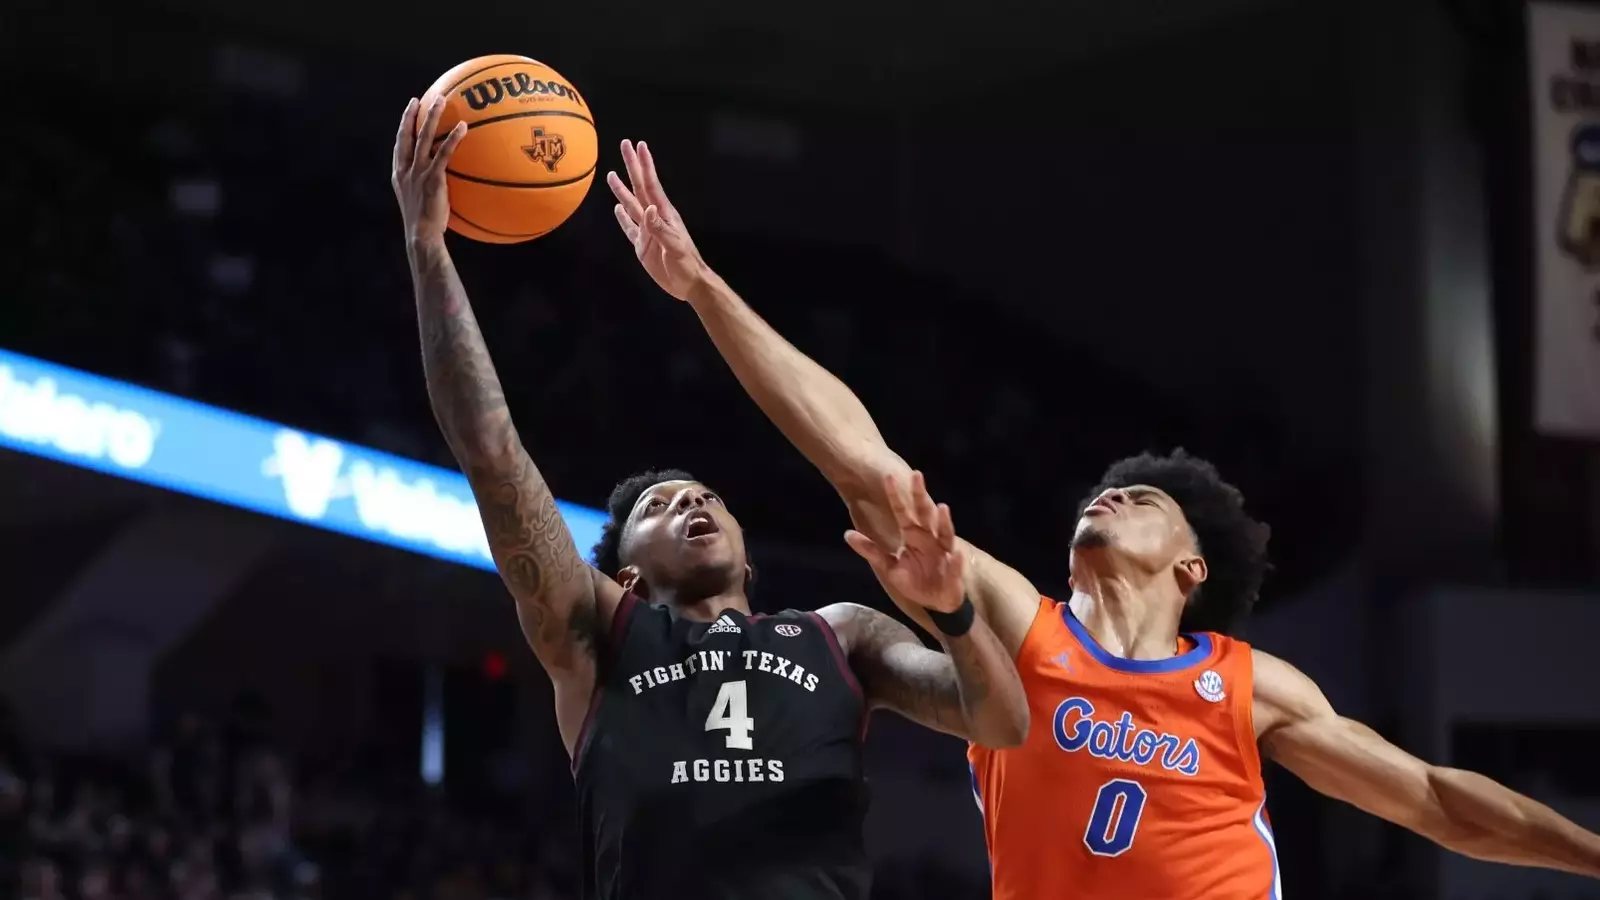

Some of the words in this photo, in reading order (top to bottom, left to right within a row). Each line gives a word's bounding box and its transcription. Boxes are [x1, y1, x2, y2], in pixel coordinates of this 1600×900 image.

[461, 73, 583, 111] Wilson
[0, 364, 156, 468] alero
[708, 624, 741, 634] adidas
[776, 625, 800, 636] SEC
[629, 650, 732, 695] FIGHTIN'
[742, 650, 819, 692] TEXAS
[704, 680, 754, 750] 4
[1053, 697, 1199, 776] Gators
[671, 759, 785, 784] AGGIES
[1083, 778, 1147, 857] 0
